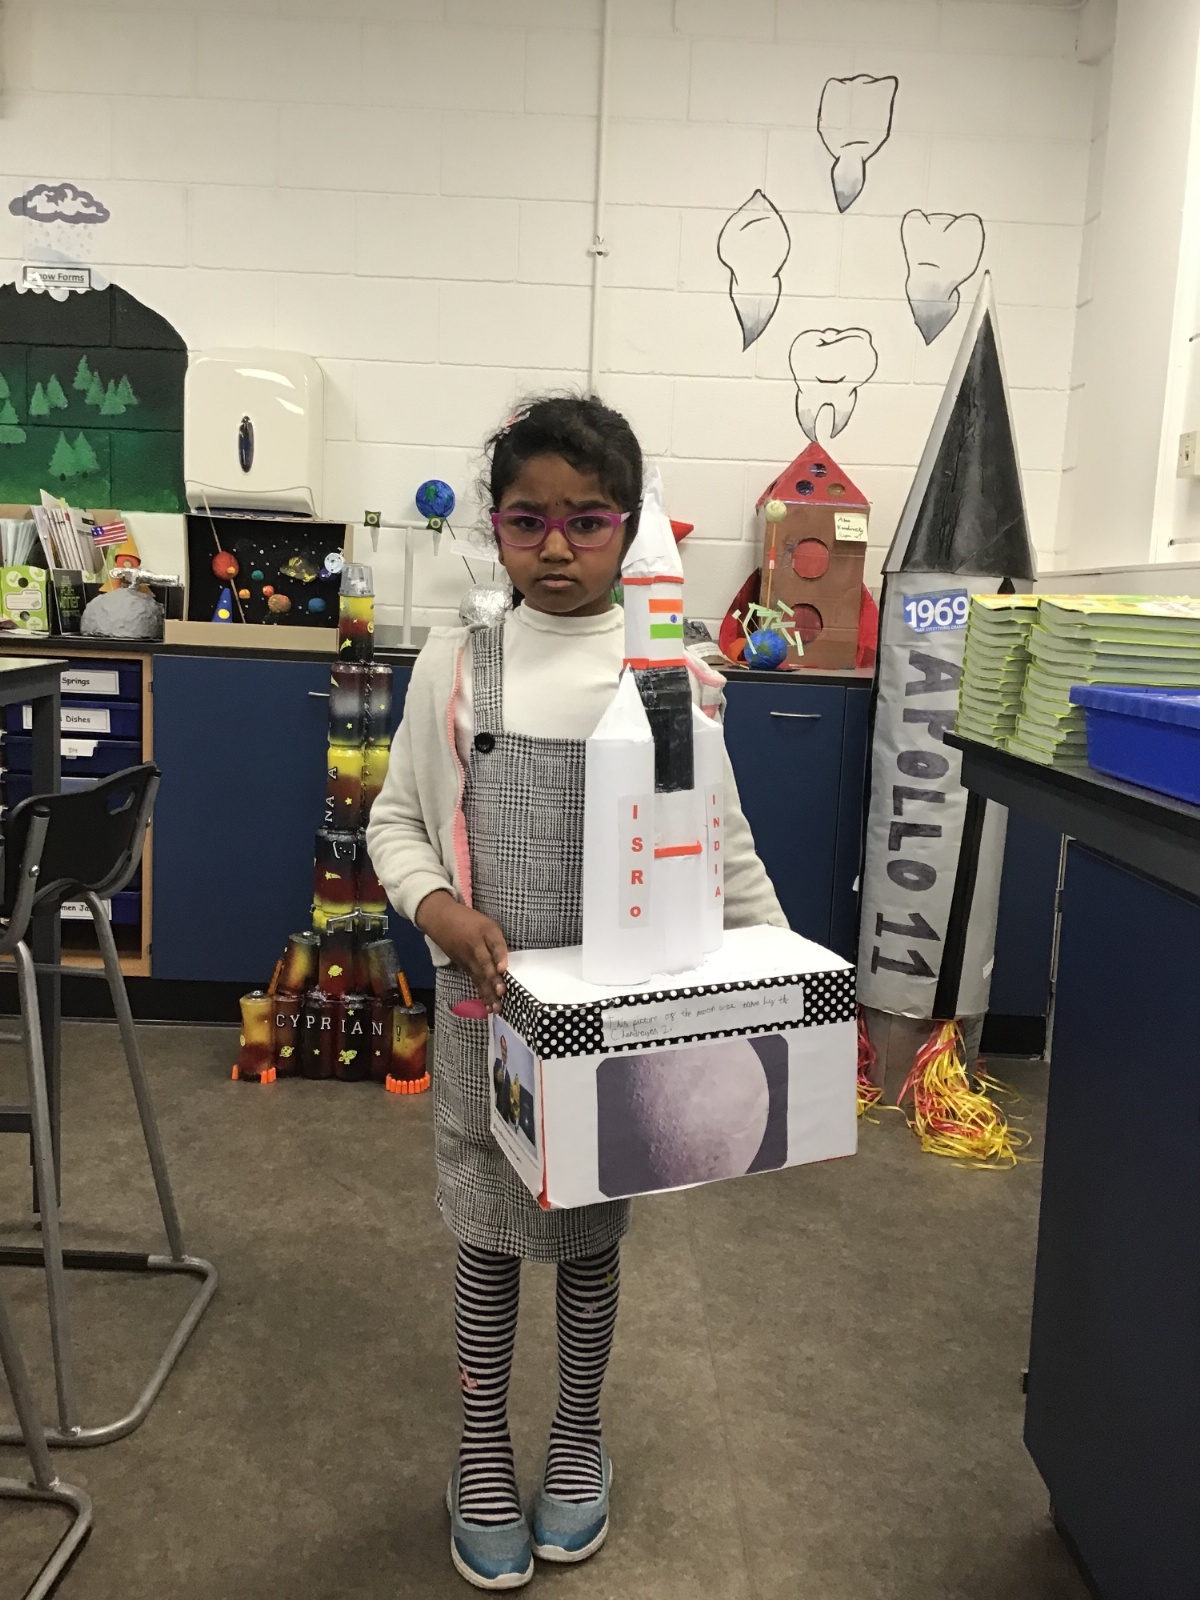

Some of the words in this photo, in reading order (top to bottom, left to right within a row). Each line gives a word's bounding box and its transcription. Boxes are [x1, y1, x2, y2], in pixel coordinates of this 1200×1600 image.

[57, 273, 84, 282] Forms
[905, 596, 970, 628] 1969
[61, 677, 90, 687] Springs
[65, 715, 91, 723] Dishes
[886, 649, 964, 892] APOLLO
[629, 804, 644, 918] ISRO
[712, 794, 721, 898] INDIA
[871, 912, 942, 979] 11
[276, 1014, 383, 1036] CYPRIAN
